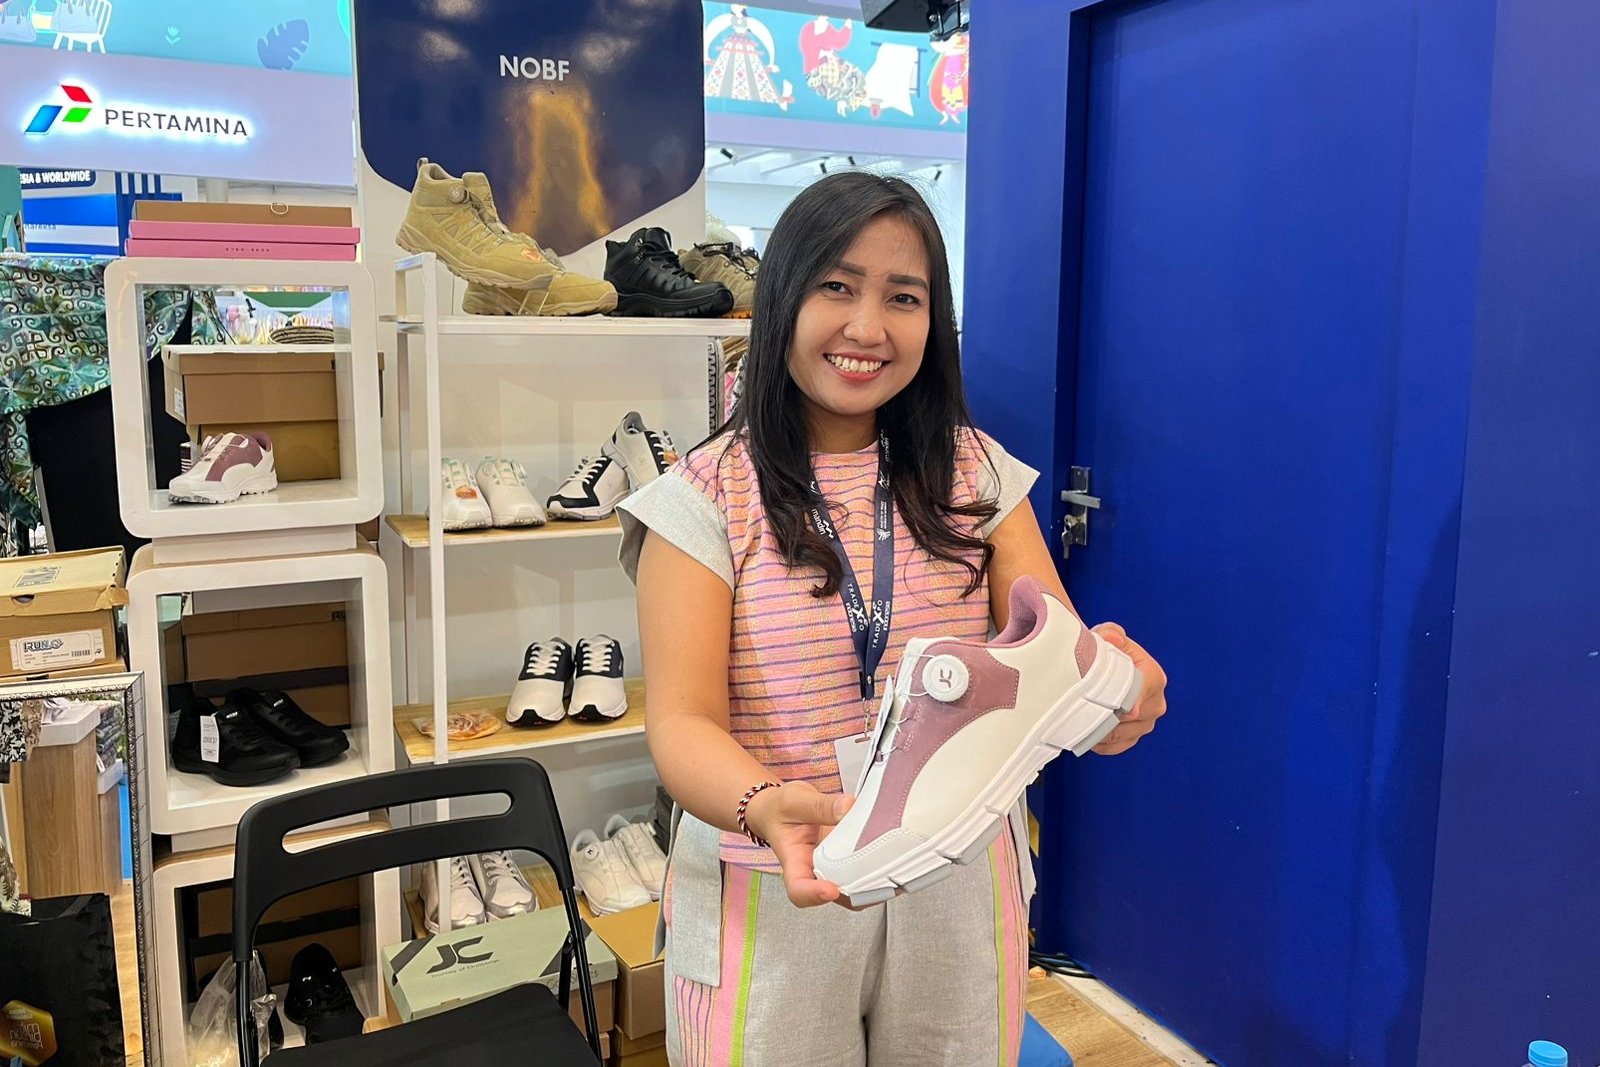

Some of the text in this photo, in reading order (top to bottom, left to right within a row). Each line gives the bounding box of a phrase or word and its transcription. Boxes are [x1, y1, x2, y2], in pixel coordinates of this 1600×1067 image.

[500, 55, 570, 81] NOBF
[105, 108, 248, 137] PERTAMINA
[42, 170, 91, 183] WORLDWIDE
[426, 935, 494, 974] JC
